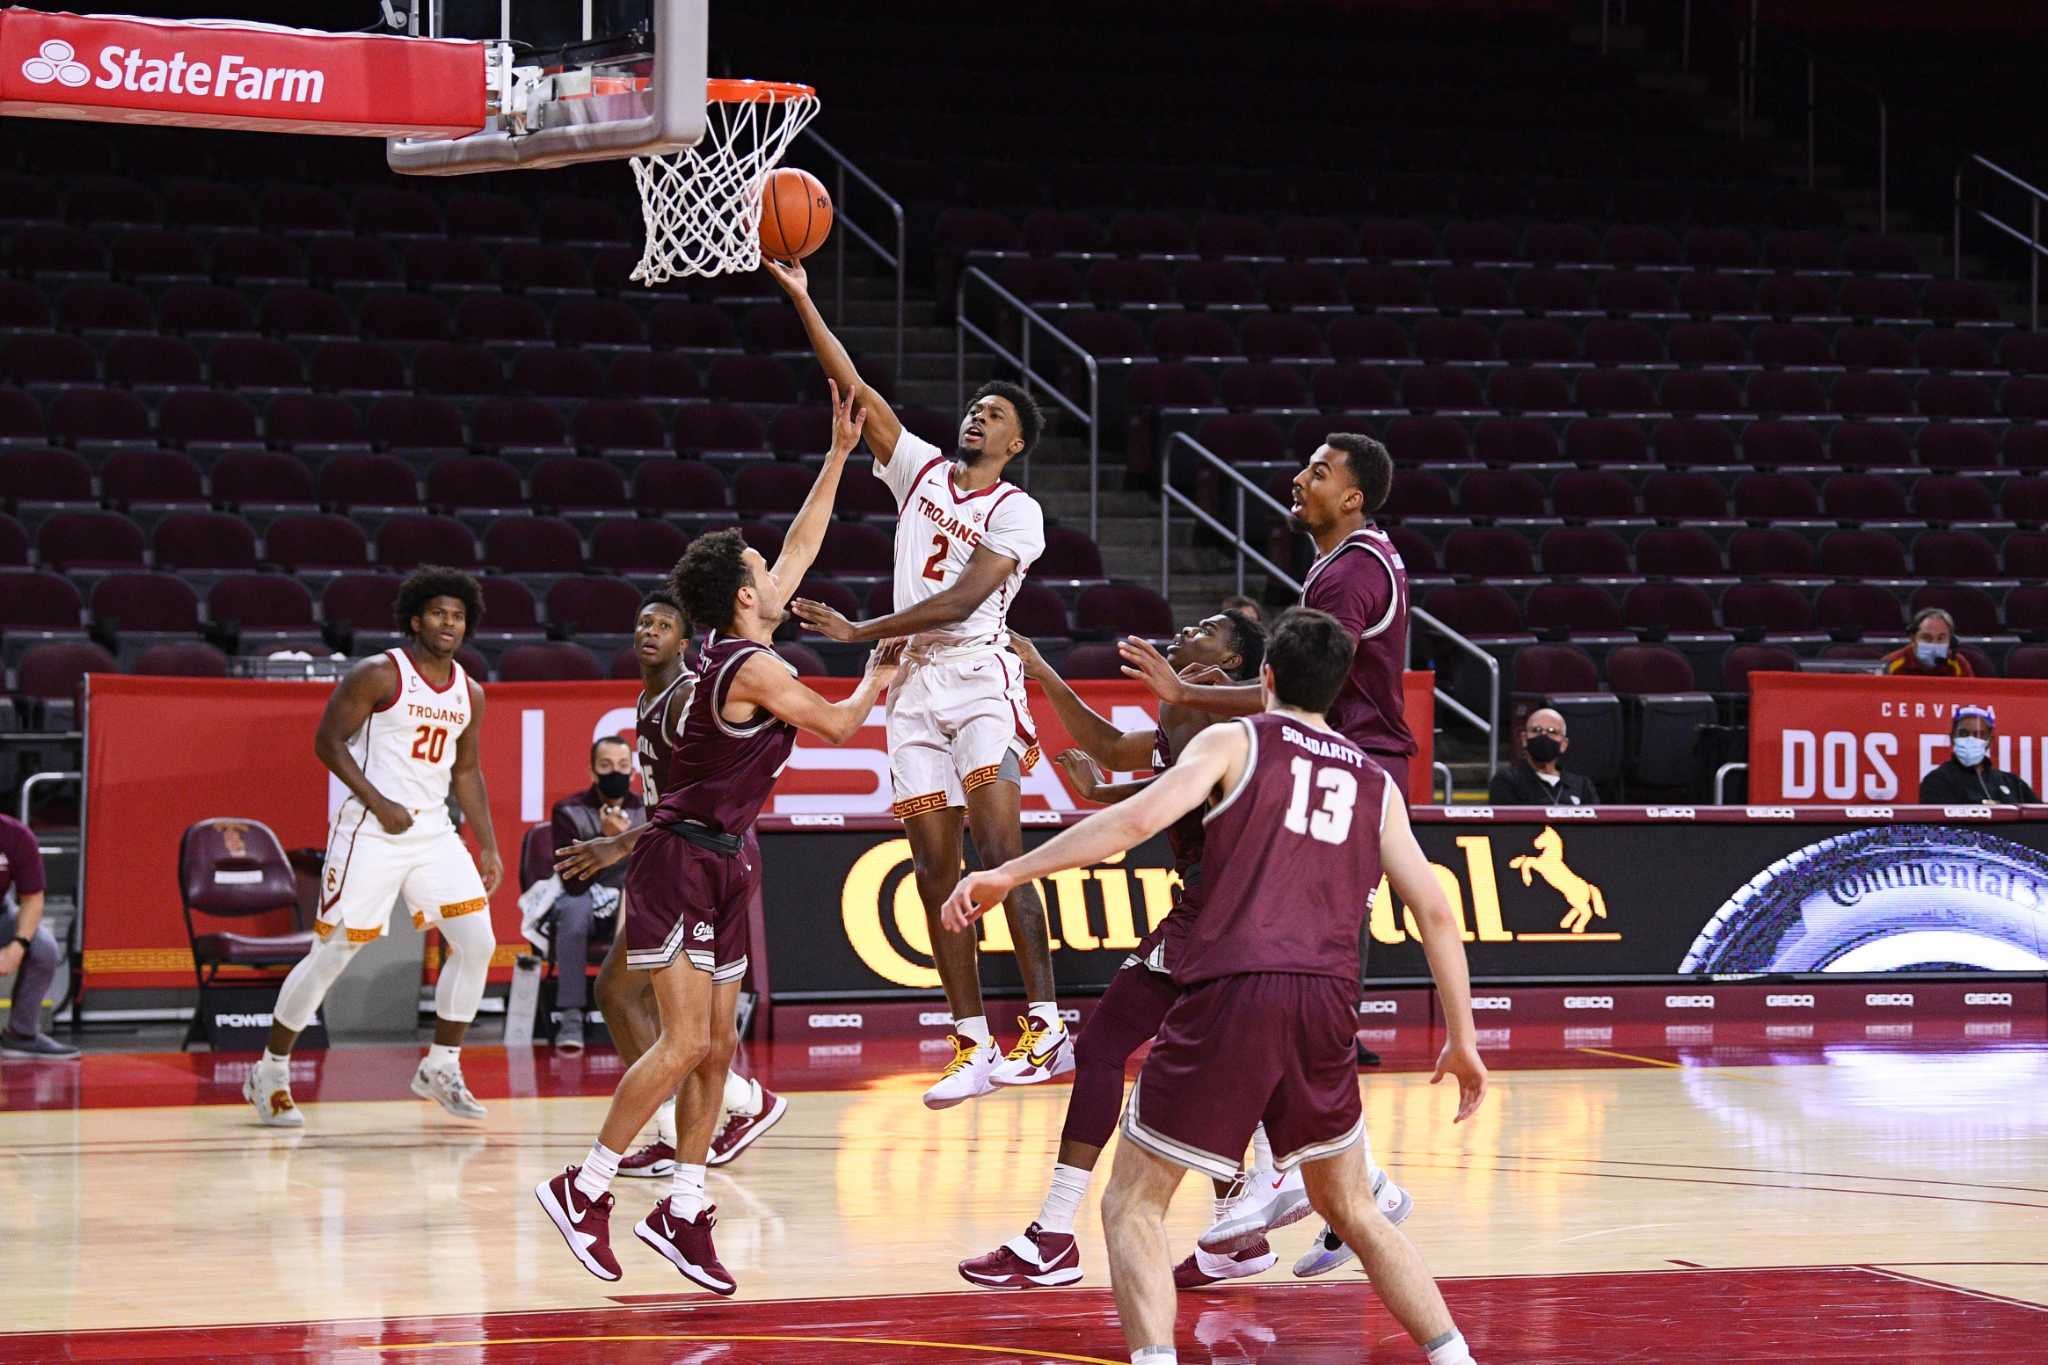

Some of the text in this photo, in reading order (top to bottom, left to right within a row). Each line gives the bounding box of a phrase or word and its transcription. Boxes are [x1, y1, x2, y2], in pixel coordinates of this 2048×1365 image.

[917, 495, 983, 549] TROJANS
[922, 533, 950, 582] 2
[407, 703, 466, 725] TROJANS
[1881, 702, 1996, 720] CERVEA
[411, 723, 448, 765] 20
[1281, 725, 1365, 768] SOLIDARITY
[1782, 729, 2048, 803] DOS EUI
[1284, 755, 1358, 846] 13
[1020, 811, 1062, 824] EICO
[1444, 807, 1494, 819] GEICO
[1546, 808, 1597, 819] GEICO
[1646, 807, 1695, 819] GEICO
[1745, 807, 1795, 819] GEICO
[1845, 807, 1894, 819] GEICO
[1944, 807, 1992, 819] GEICO
[791, 814, 845, 826] GEICO
[841, 837, 1514, 988] Cntintal
[1471, 997, 1511, 1010] EICO
[1564, 997, 1614, 1010] GEICO
[1666, 996, 1715, 1009] GEICO
[1766, 995, 1815, 1008] GEICO
[1866, 994, 1914, 1007] GEICO
[1965, 992, 2013, 1006] GEICO
[1360, 1000, 1397, 1014] EICO
[808, 1014, 863, 1028] GEICO
[919, 1012, 954, 1026] GEIC
